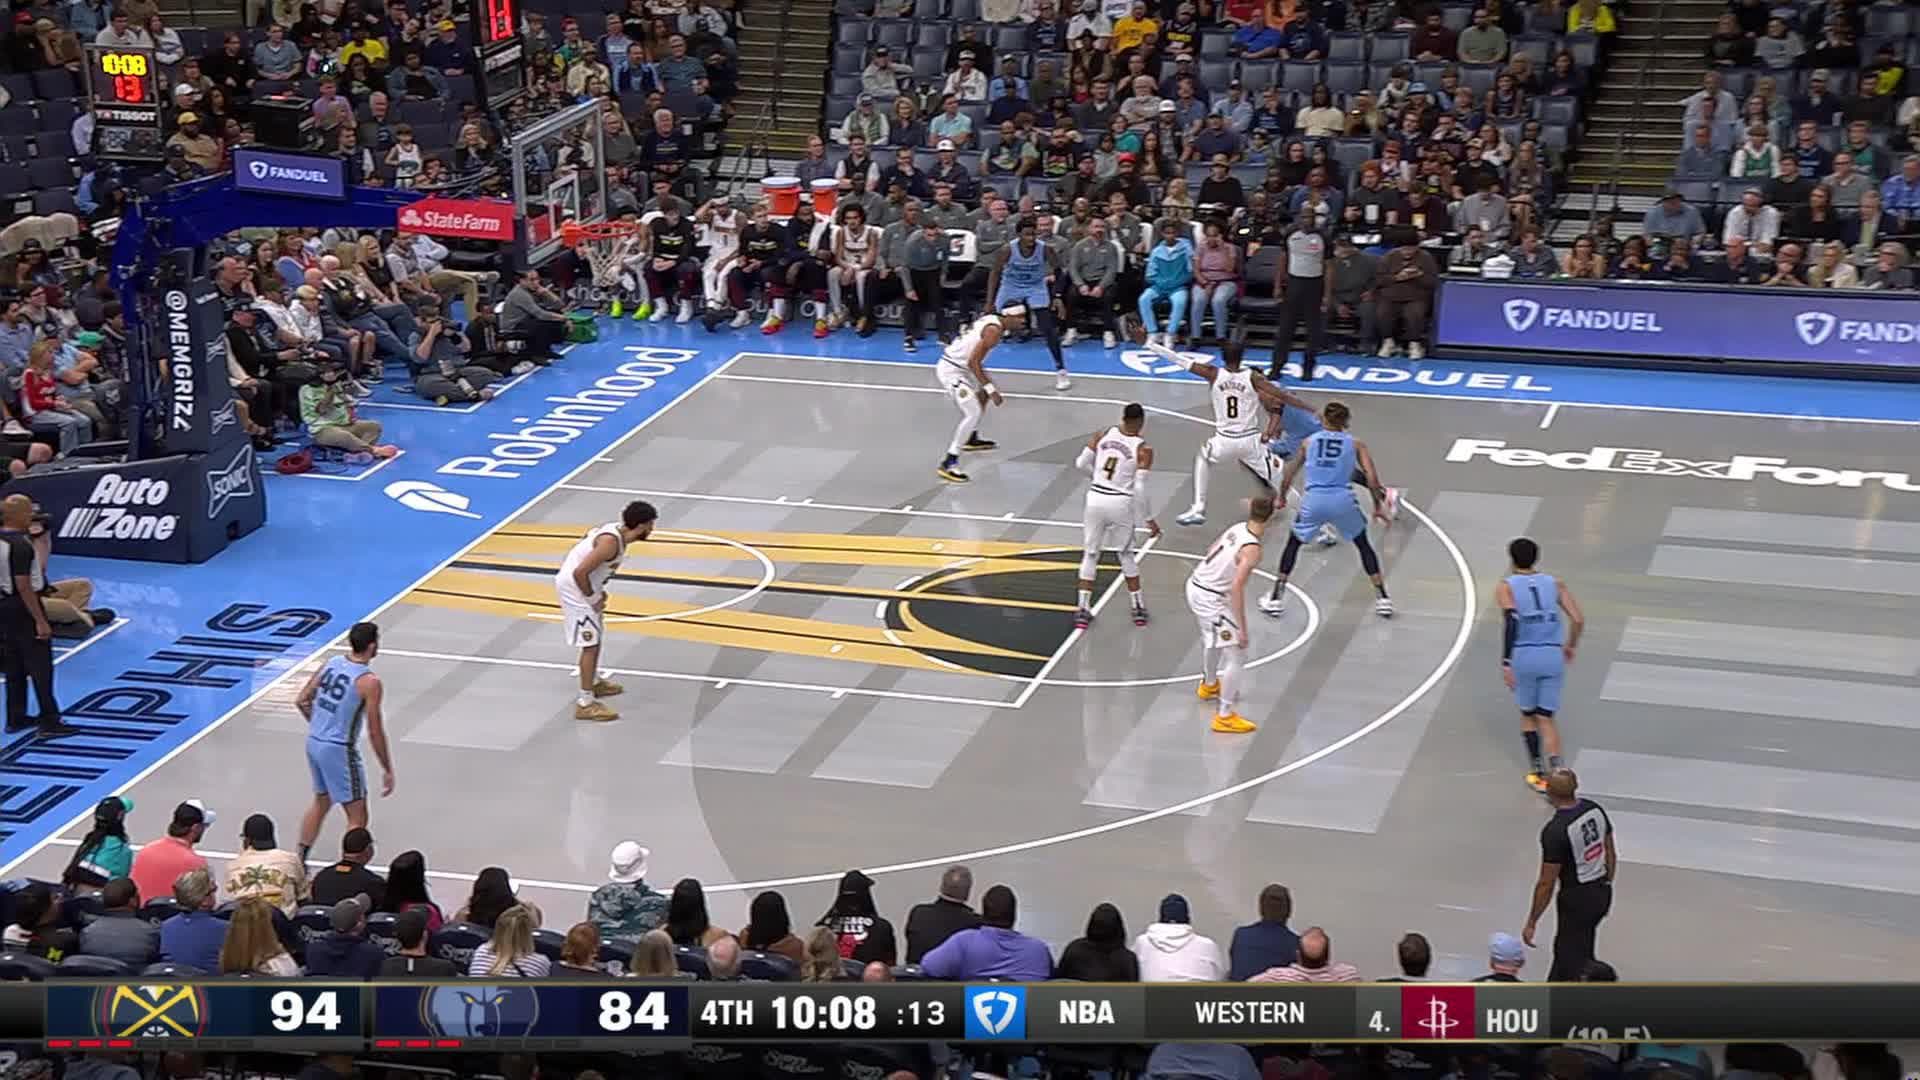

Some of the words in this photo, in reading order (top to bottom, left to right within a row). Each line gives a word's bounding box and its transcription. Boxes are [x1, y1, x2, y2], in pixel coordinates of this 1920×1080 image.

[102, 53, 147, 76] 10:08
[115, 75, 143, 103] 13
[112, 110, 157, 121] TISSOT
[269, 166, 329, 183] FANDUEL
[1543, 308, 1663, 333] FANDUEL
[1840, 321, 1920, 343] FAND
[435, 345, 702, 478] Robinhood
[1226, 395, 1239, 419] 8
[1316, 438, 1343, 458] 15
[213, 465, 249, 496] SONIC
[1102, 456, 1119, 480] 4
[88, 473, 170, 505] Auto
[88, 508, 177, 540] Zone
[1528, 586, 1543, 611] 1
[318, 667, 351, 701] 46
[0, 602, 333, 850] EMPHIS
[1581, 818, 1600, 847] 23
